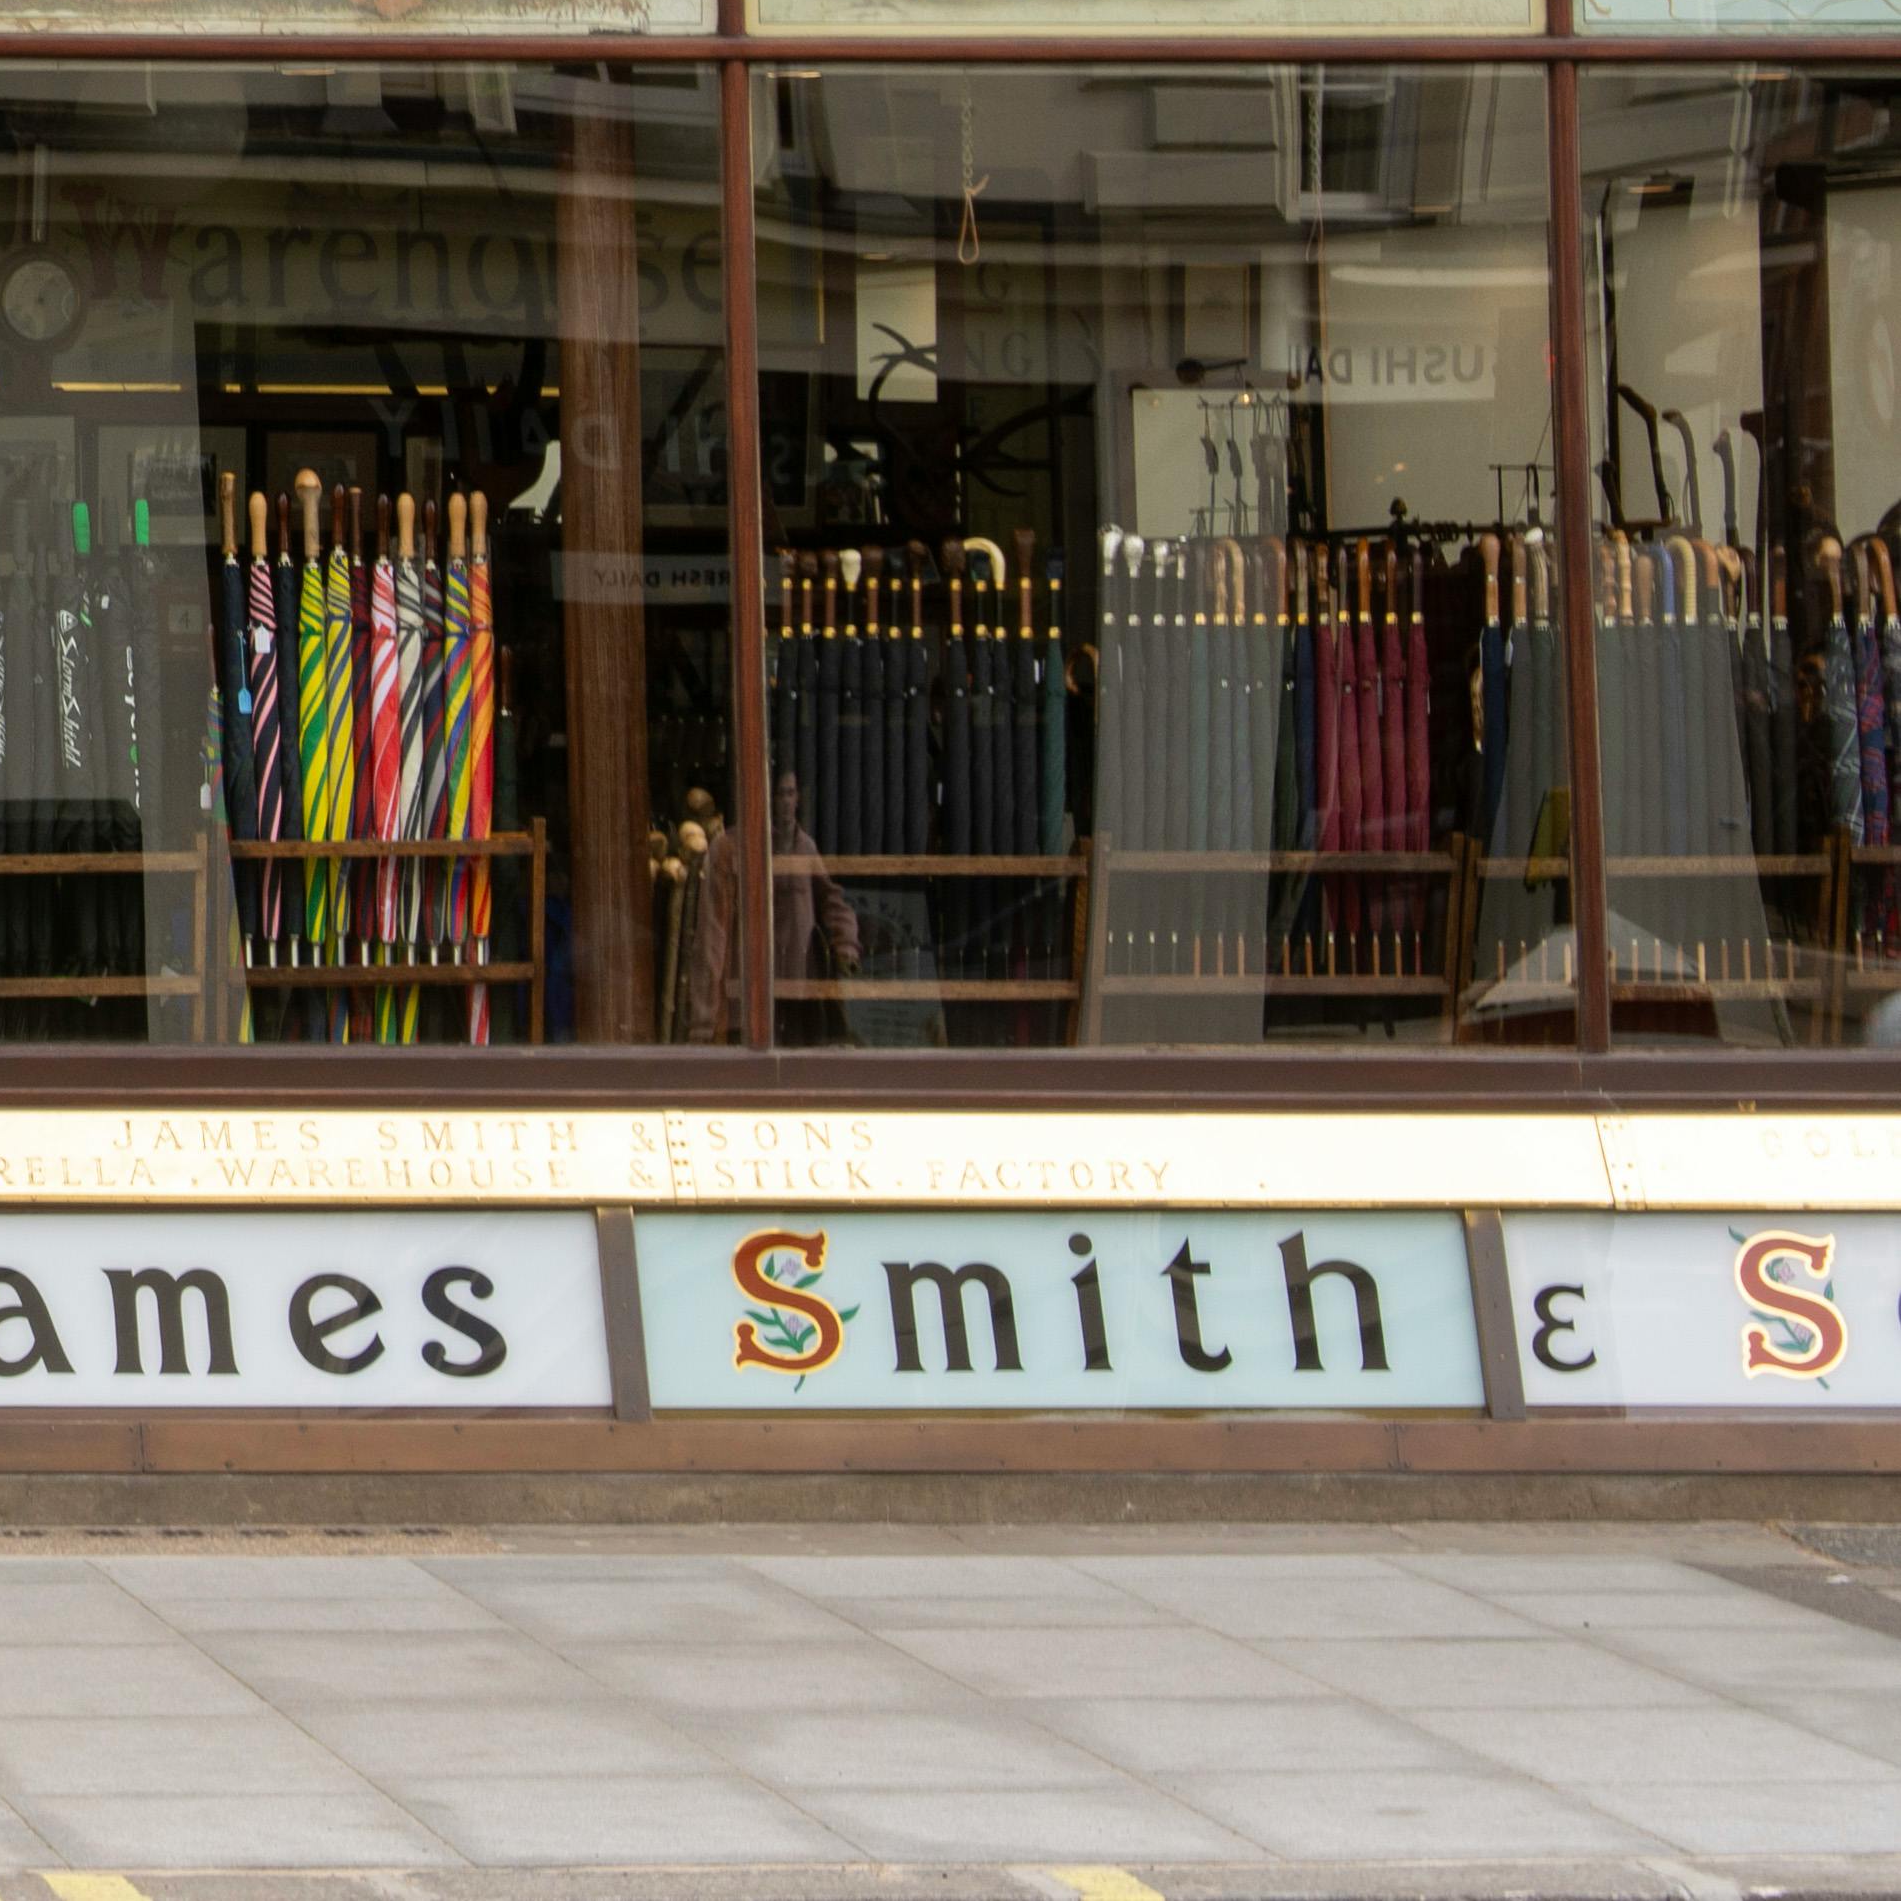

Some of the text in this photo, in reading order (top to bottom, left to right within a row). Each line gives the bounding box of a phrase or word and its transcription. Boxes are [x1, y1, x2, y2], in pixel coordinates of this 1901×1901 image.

[112, 1119, 876, 1153] JAMES SMITH & SONS
[629, 1156, 657, 1188] &
[925, 1156, 1177, 1190] FACTORY
[731, 1228, 1392, 1378] Smith
[1733, 1228, 1901, 1383] S
